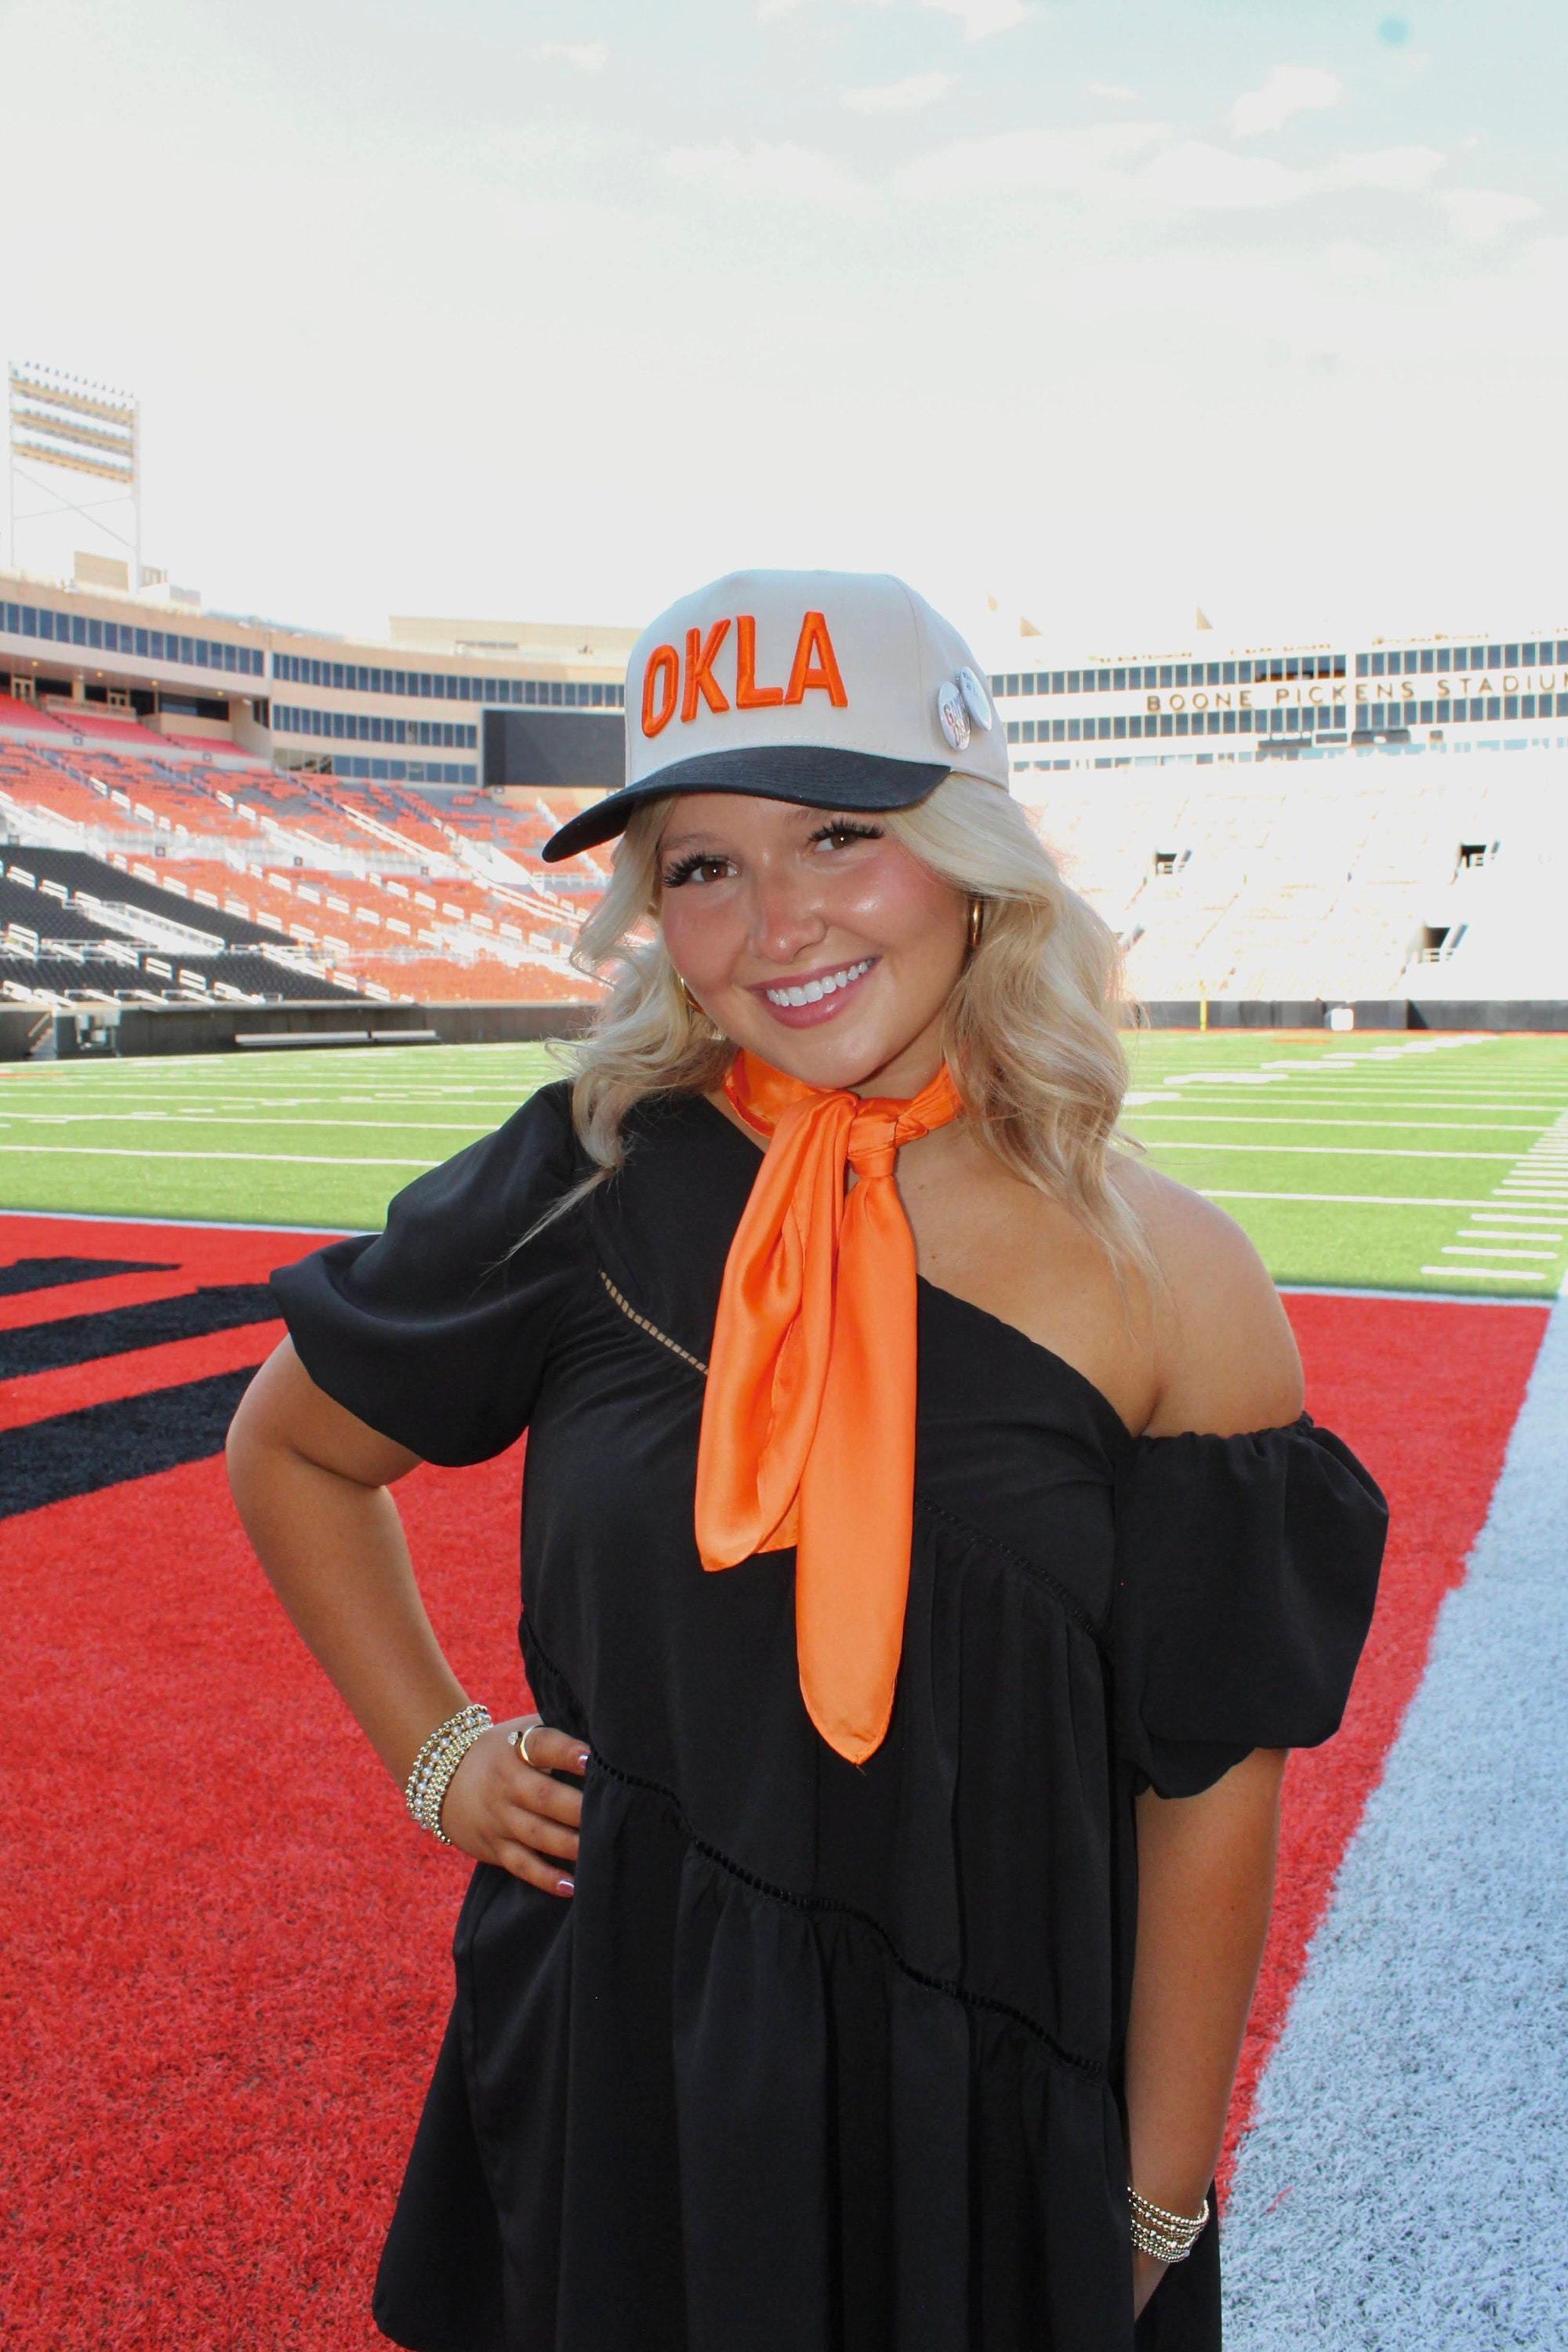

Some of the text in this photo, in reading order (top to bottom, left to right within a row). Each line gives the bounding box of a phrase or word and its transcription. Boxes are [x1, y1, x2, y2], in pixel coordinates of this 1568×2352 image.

[641, 610, 848, 738] OKLA
[1147, 672, 1568, 713] BOONE PICKENS STADIU
